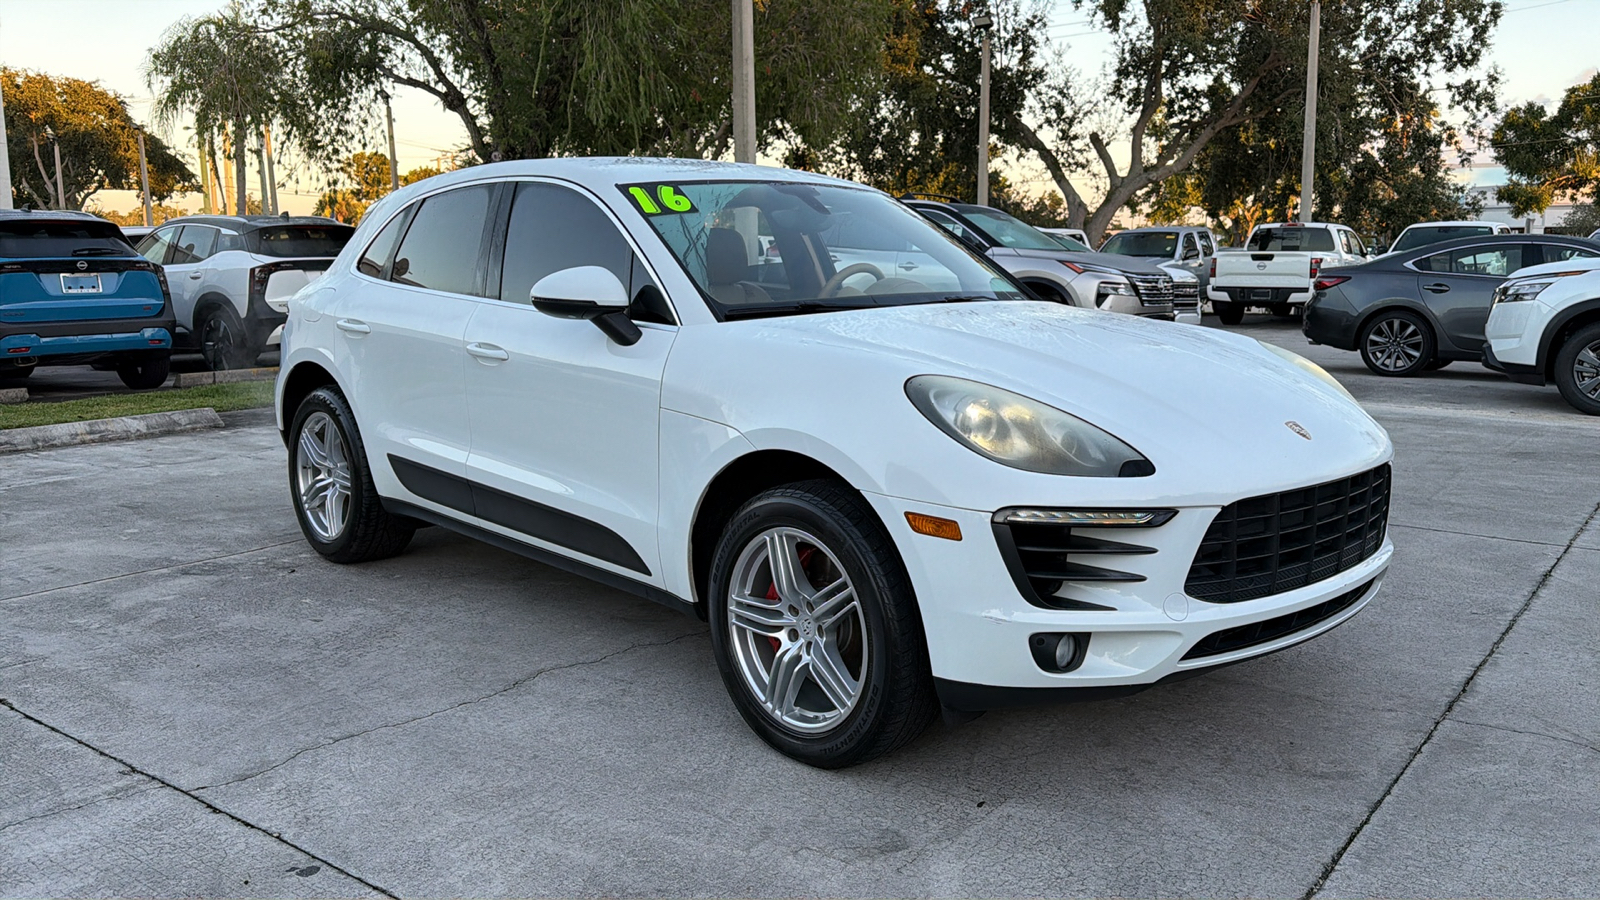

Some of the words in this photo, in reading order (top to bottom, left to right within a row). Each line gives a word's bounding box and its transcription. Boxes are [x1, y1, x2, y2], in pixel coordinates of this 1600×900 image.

[628, 185, 692, 214] 16
[712, 511, 761, 584] CONTINENTAL
[819, 684, 879, 755] CONTINENTAL
